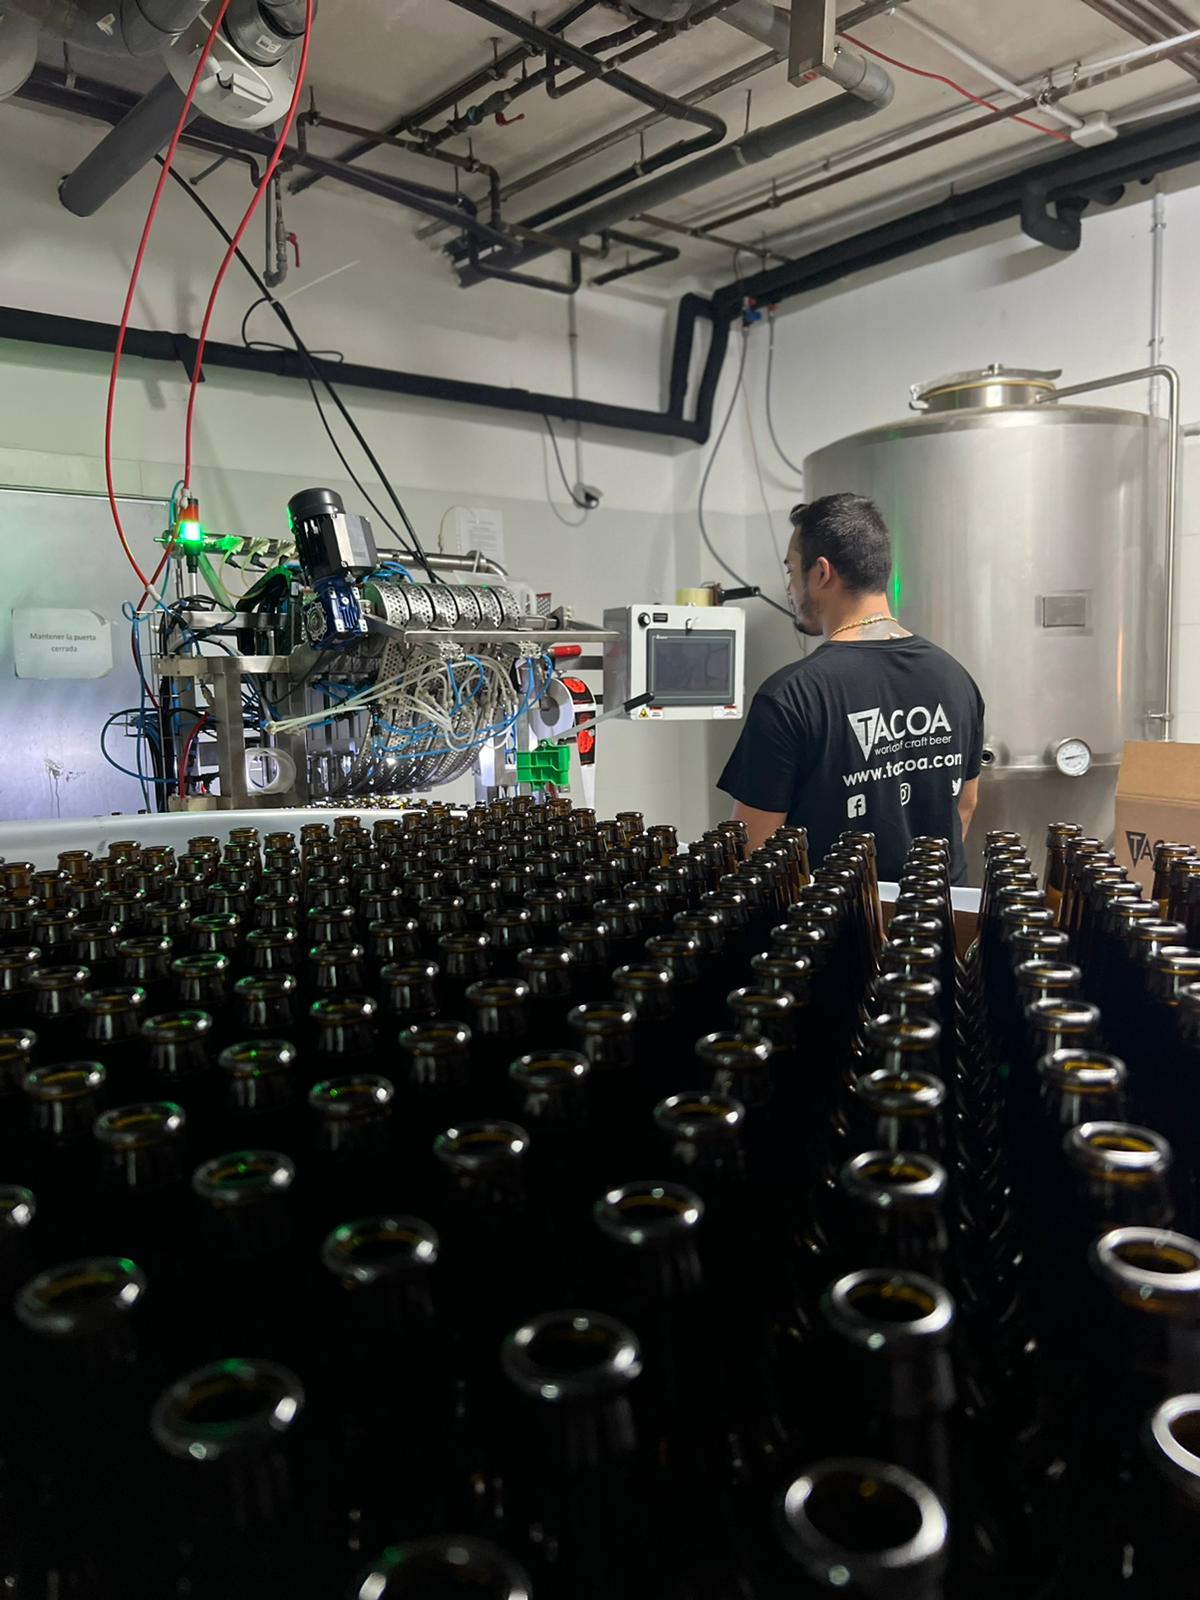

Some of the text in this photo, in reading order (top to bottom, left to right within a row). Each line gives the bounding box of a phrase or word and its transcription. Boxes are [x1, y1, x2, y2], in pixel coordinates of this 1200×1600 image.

[29, 632, 97, 642] Mantener la puerta
[50, 645, 78, 653] cerrada
[847, 703, 952, 762] TACOA
[904, 736, 928, 749] craft
[929, 735, 952, 746] beer
